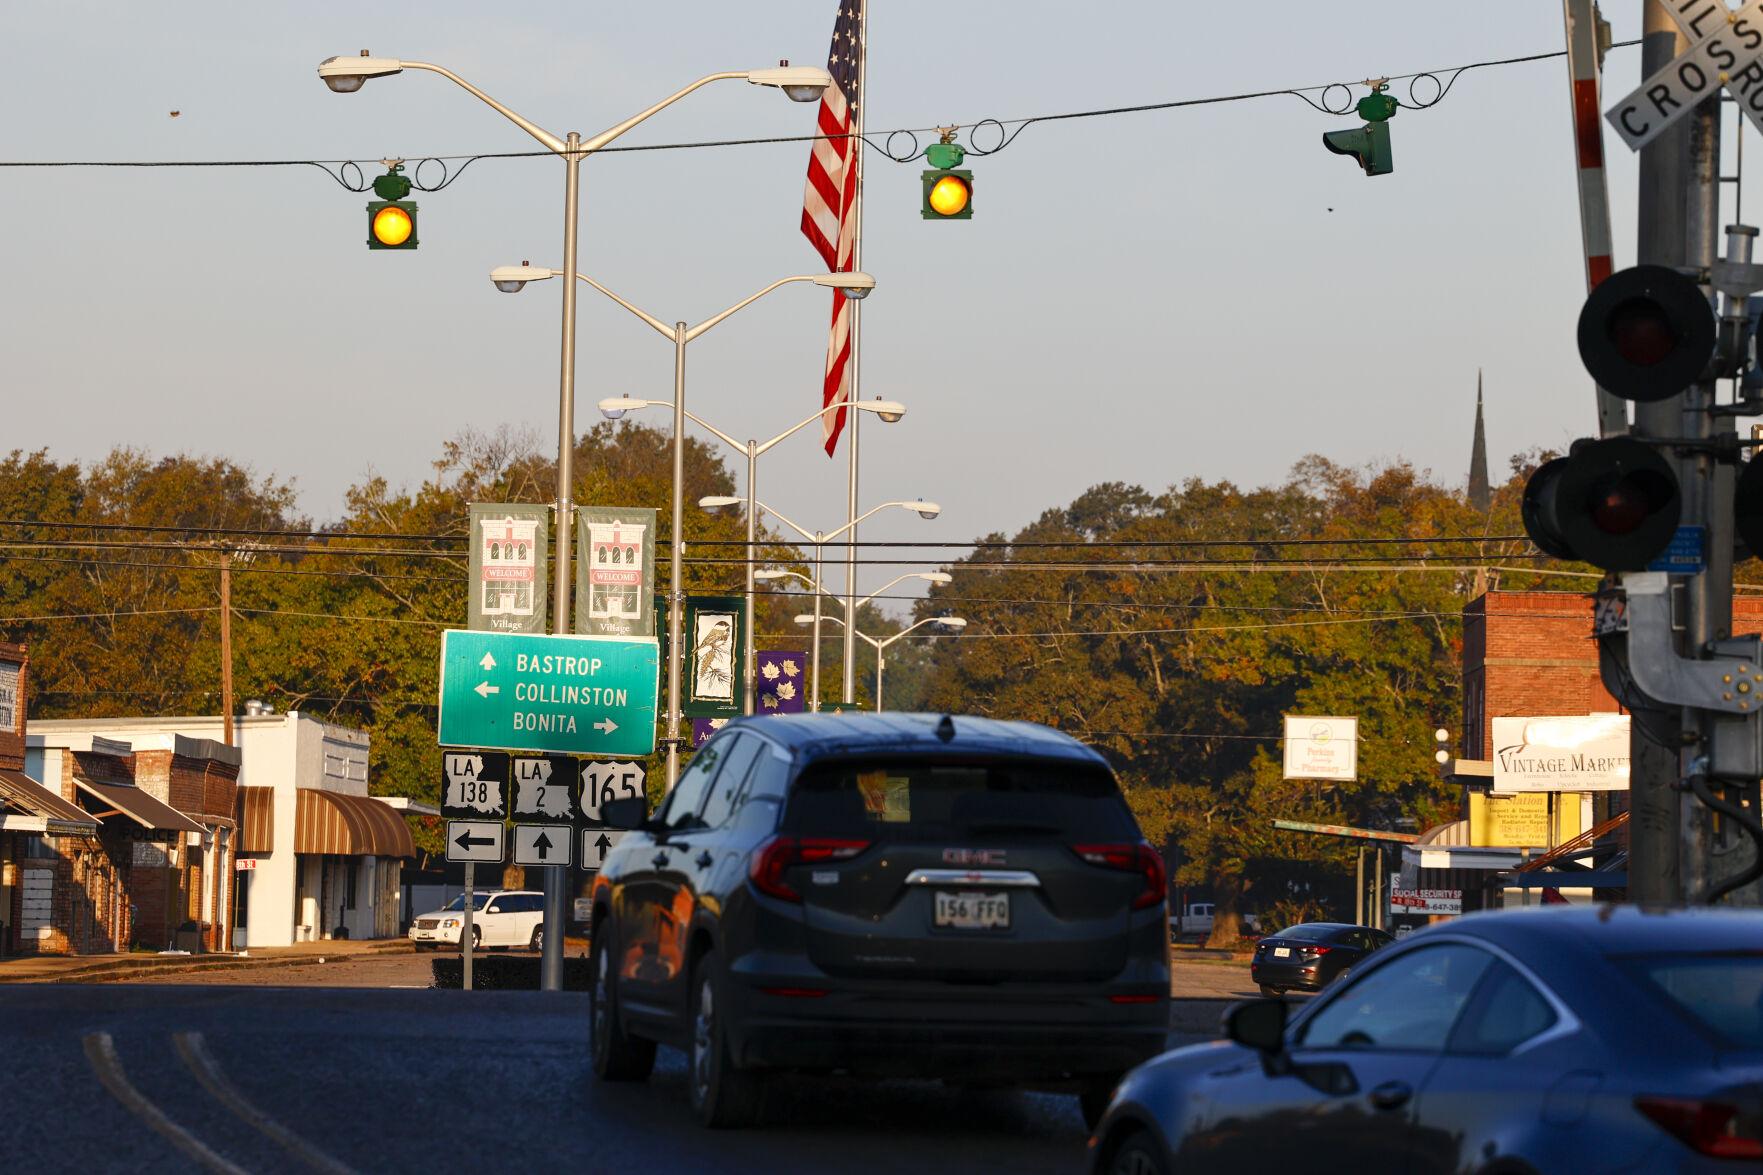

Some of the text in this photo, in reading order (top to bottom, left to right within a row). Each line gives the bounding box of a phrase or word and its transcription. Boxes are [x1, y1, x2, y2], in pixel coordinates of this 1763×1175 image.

[1620, 4, 1763, 137] CROSS
[488, 569, 528, 578] WELCOME
[596, 573, 636, 582] WELCOME
[492, 620, 523, 629] Village
[600, 623, 630, 633] Village
[516, 653, 602, 676] BASTROP
[515, 682, 627, 707] COLLINSTON
[513, 711, 577, 734] BONITA
[453, 758, 474, 777] LA
[521, 762, 542, 780] LA
[1500, 752, 1566, 773] VINTAGE
[460, 781, 488, 803] 138
[536, 786, 545, 807] 2
[589, 773, 636, 808] 165
[1505, 795, 1544, 806] Station
[943, 848, 1007, 865] GMC
[1393, 889, 1419, 898] SOCIAL
[1420, 889, 1453, 899] SECURITY
